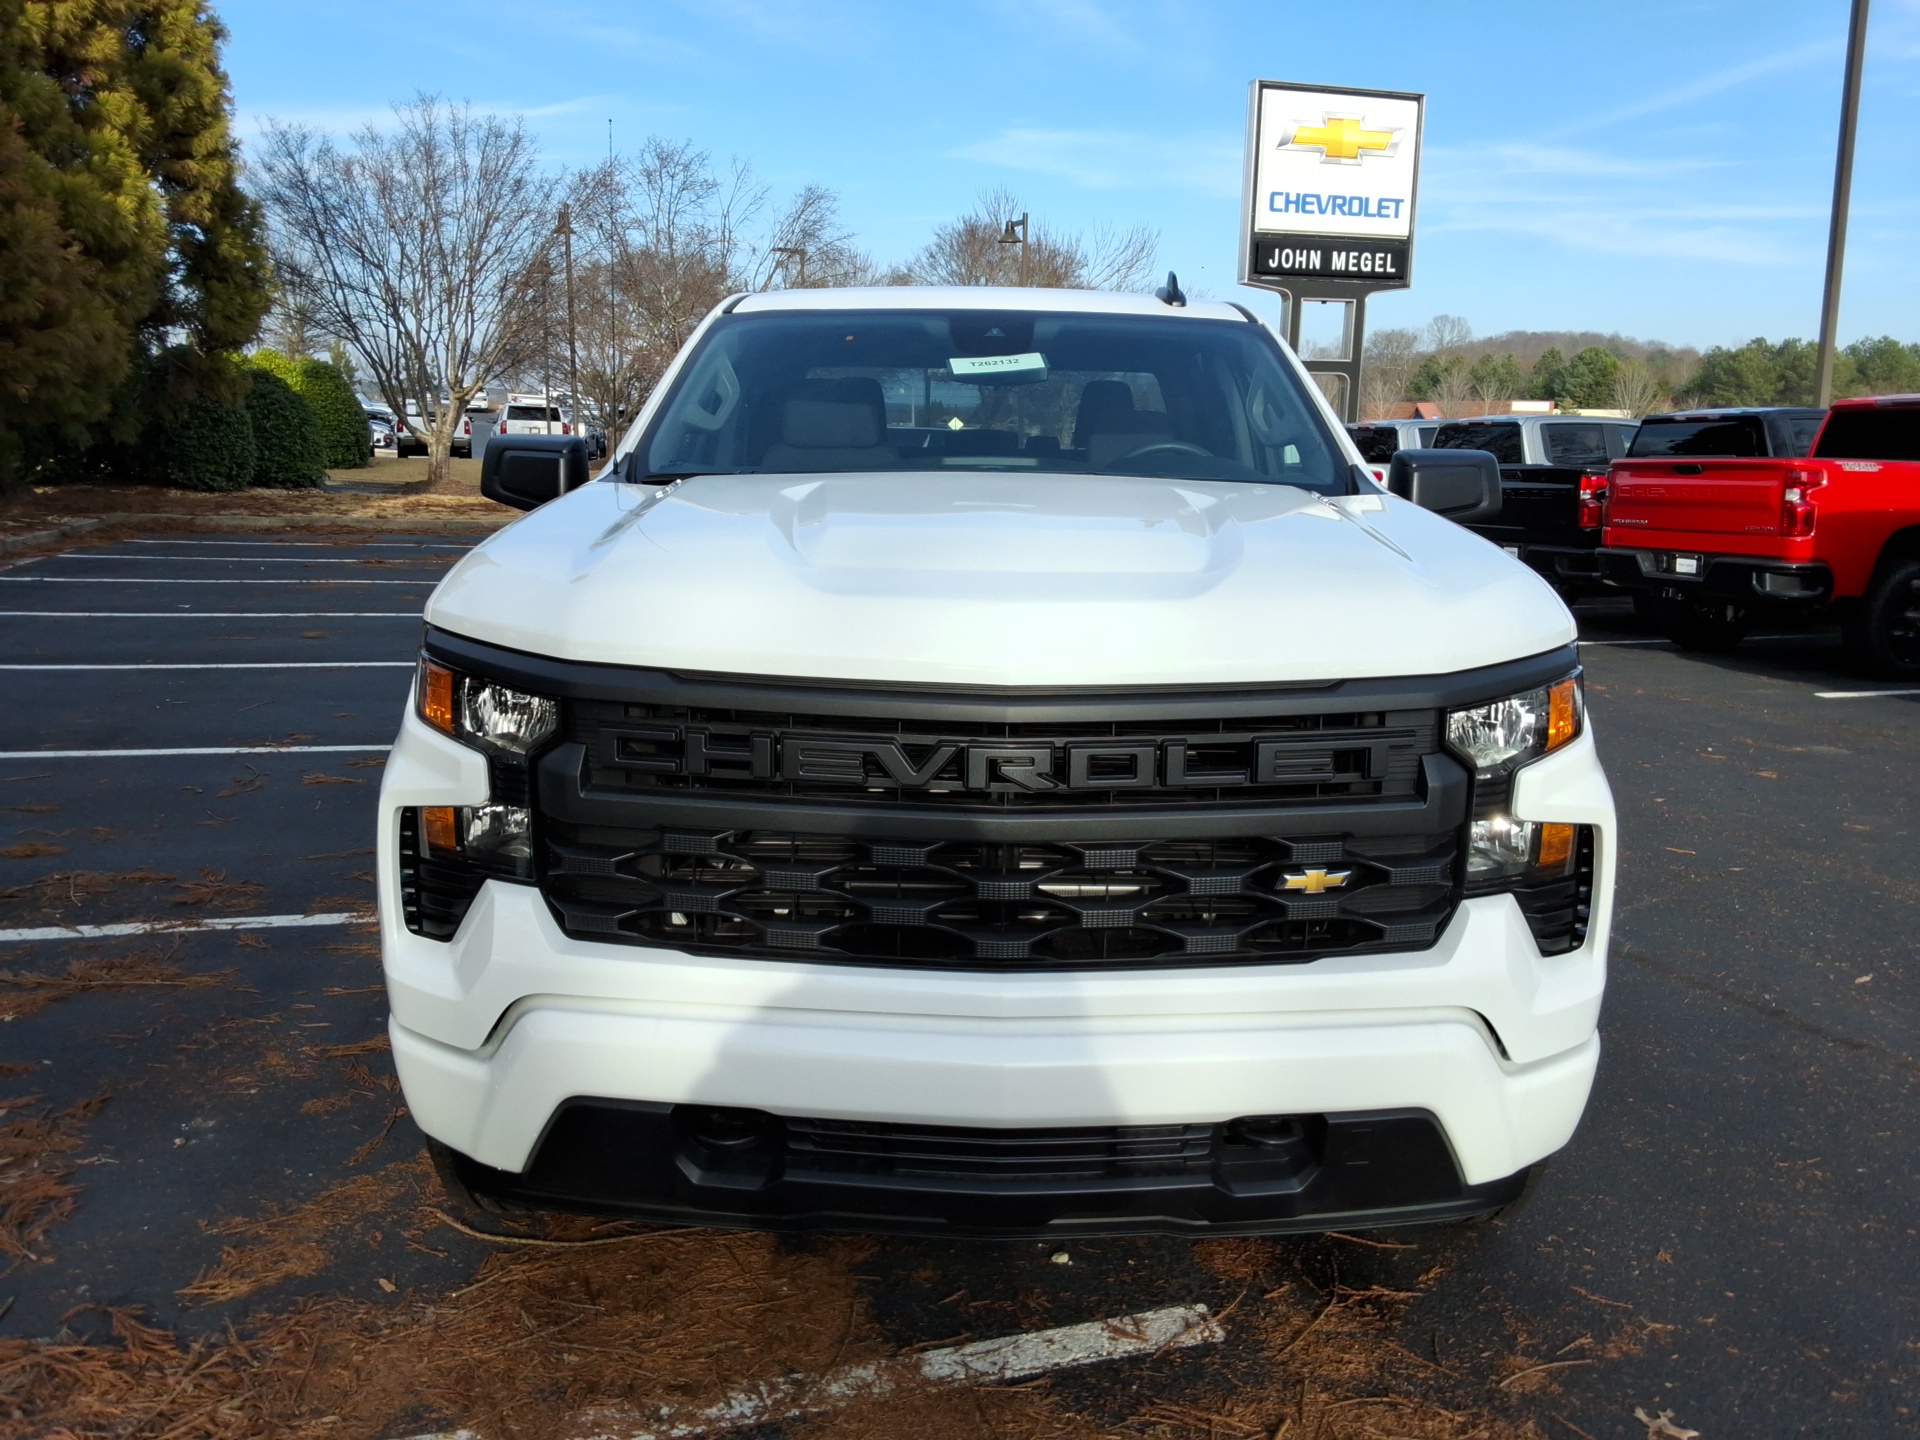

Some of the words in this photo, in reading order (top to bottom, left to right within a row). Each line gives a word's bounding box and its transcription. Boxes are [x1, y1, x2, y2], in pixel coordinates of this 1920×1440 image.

[1268, 191, 1405, 219] CHEVROLET
[1268, 248, 1322, 270] JOHN
[1331, 251, 1397, 273] MEGEL
[969, 358, 1020, 367] T262132
[1617, 486, 1764, 500] CHEVROLET
[596, 722, 1417, 791] CHEVROLET
